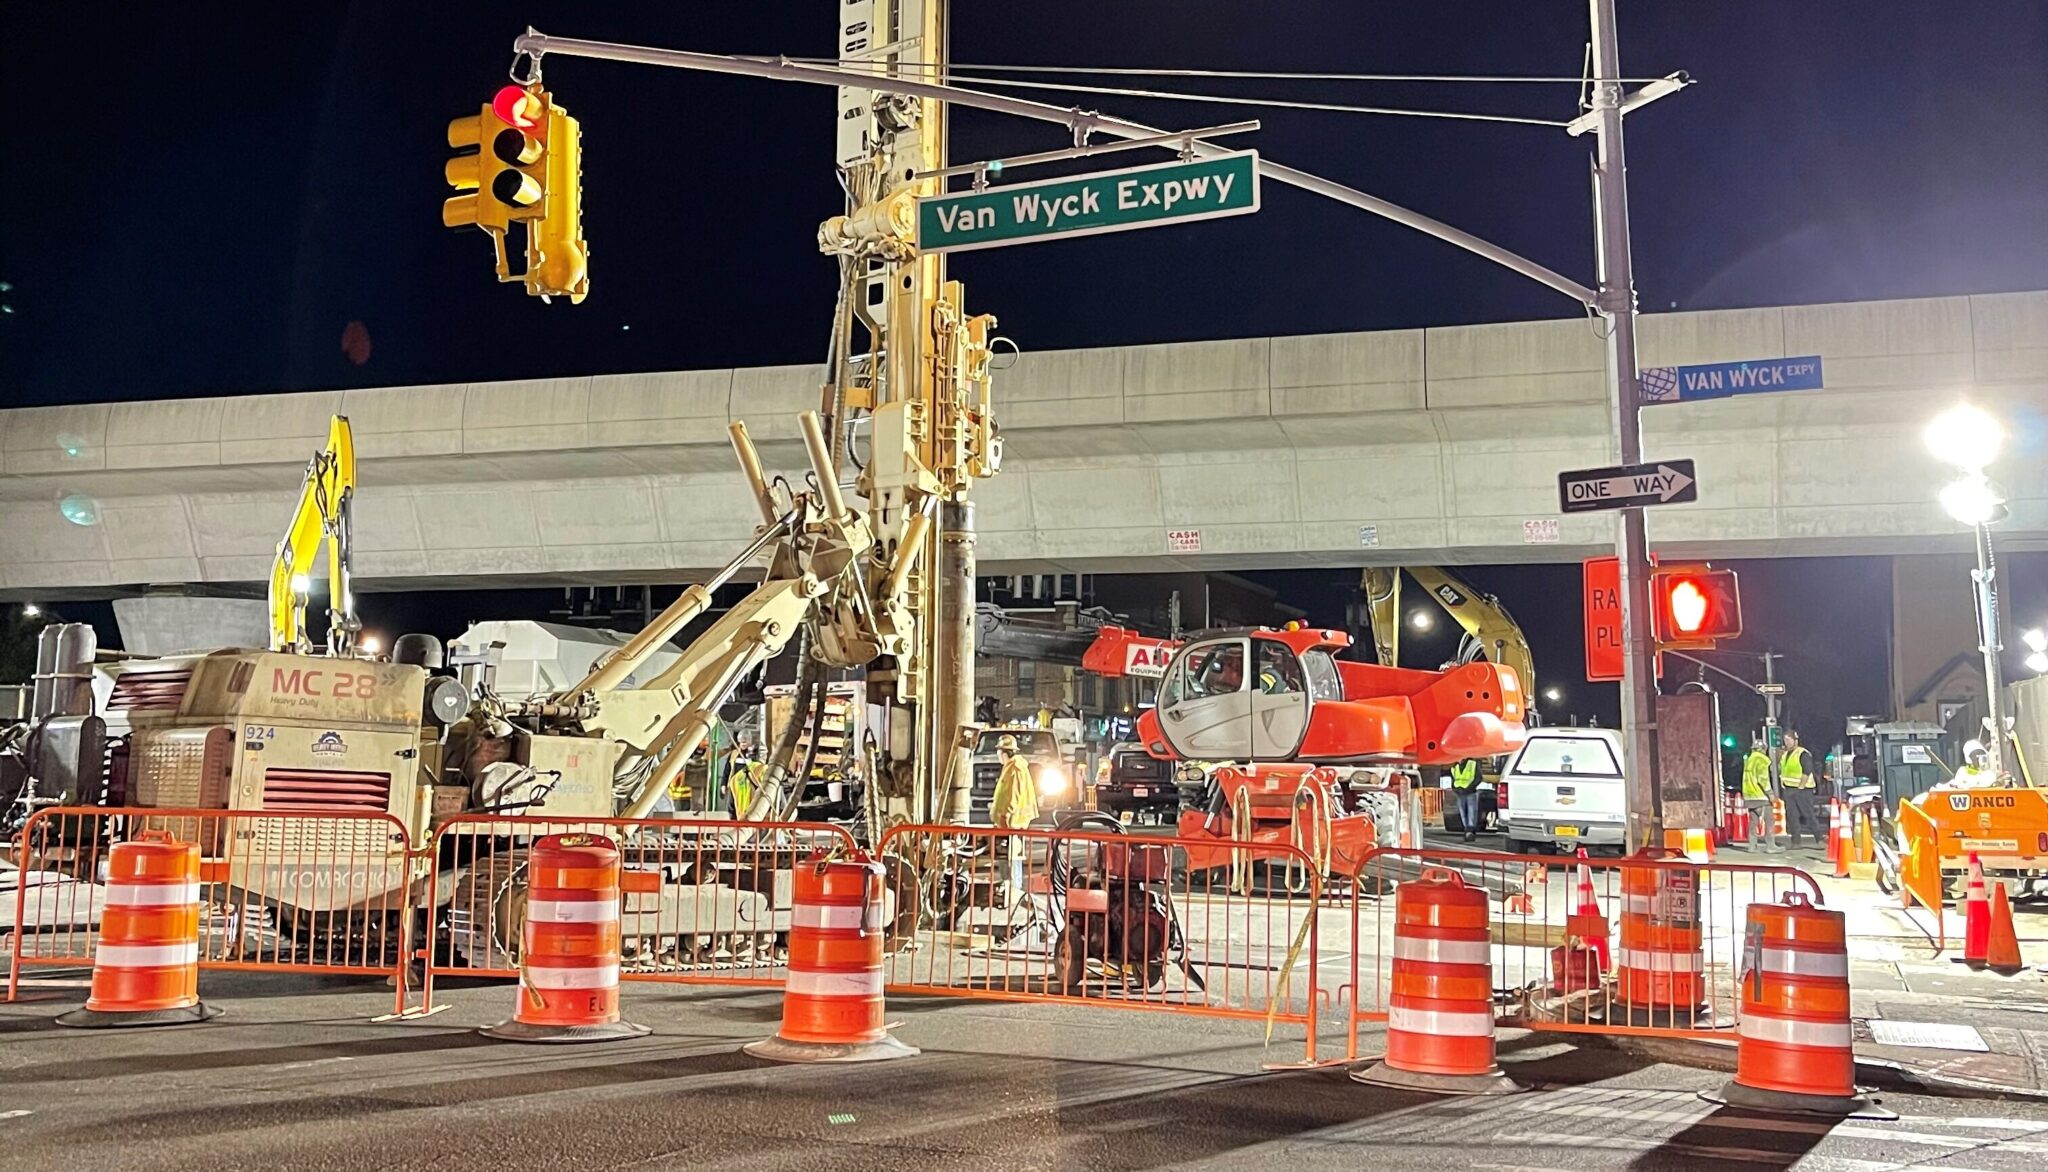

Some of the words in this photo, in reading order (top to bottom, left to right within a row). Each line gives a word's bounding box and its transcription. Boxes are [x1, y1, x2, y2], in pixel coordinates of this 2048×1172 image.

[937, 203, 995, 234] Van
[1013, 187, 1100, 227] Wyck
[1118, 173, 1235, 211] Expwy
[1685, 370, 1723, 391] VAN
[1729, 366, 1784, 388] WYCK
[1787, 363, 1815, 376] EXPY
[1572, 481, 1611, 499] ONE
[1633, 474, 1676, 493] WAY
[1169, 531, 1198, 539] CASH
[1439, 586, 1459, 604] CAT
[1593, 588, 1618, 611] RA
[1597, 626, 1622, 648] PL
[1130, 667, 1162, 676] EQUIPME
[272, 668, 323, 696] MC
[333, 672, 378, 699] 28
[270, 696, 296, 707] Heavy
[299, 698, 320, 708] Duty
[246, 726, 275, 740] 924
[1951, 796, 2015, 808] WANCO
